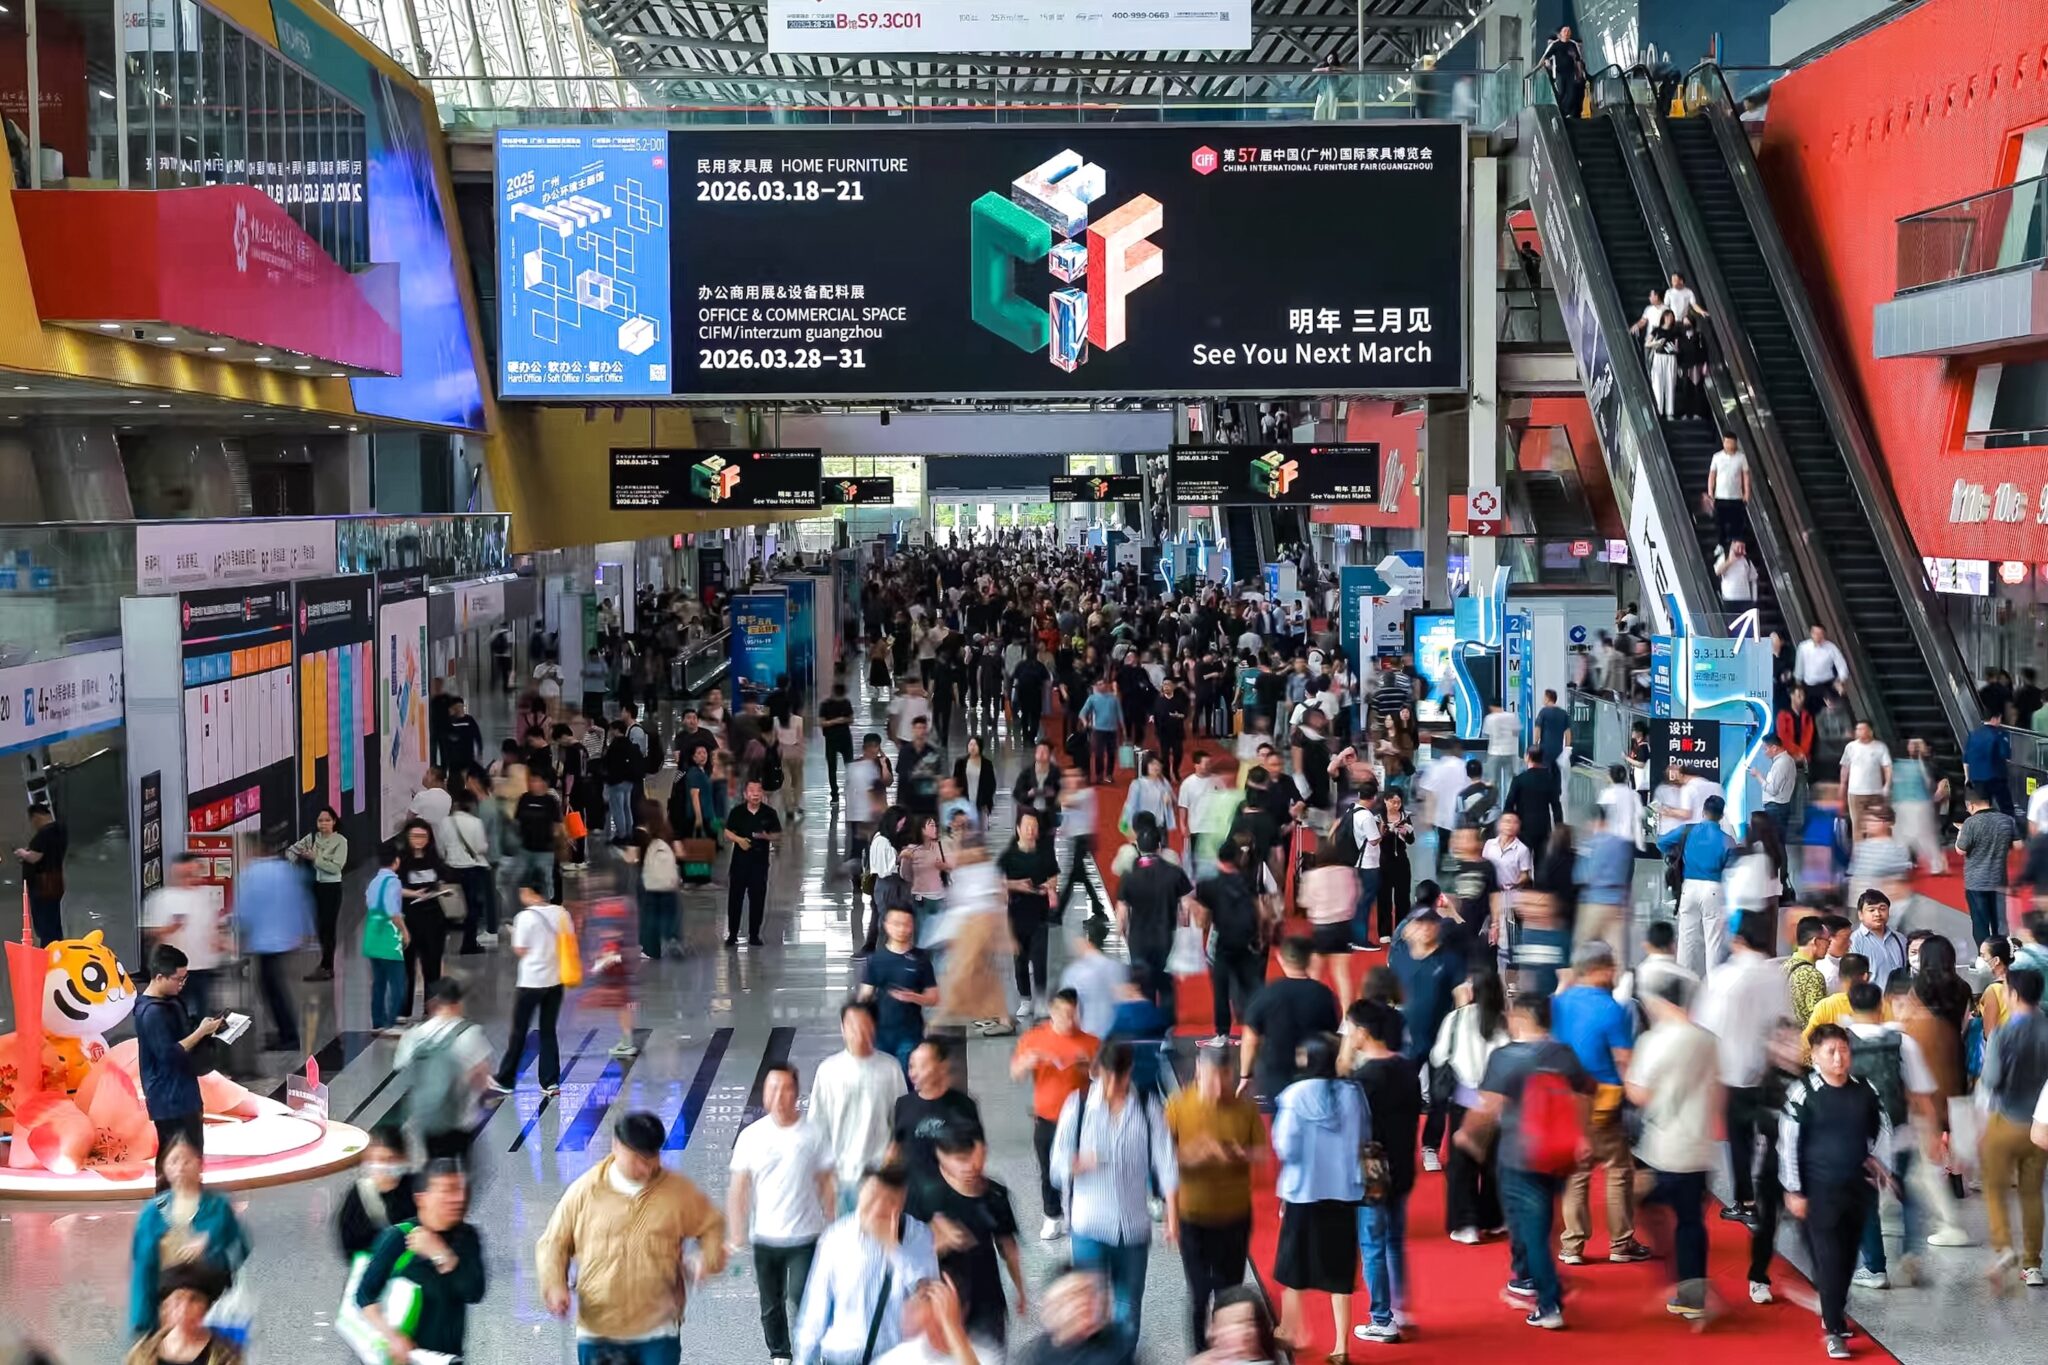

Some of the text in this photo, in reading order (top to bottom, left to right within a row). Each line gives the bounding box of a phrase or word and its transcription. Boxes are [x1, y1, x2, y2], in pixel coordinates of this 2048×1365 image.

[697, 158, 908, 174] 民用家具展 HOME FURNITURE
[1223, 164, 1248, 172] CHINA
[1250, 163, 1312, 172] INTERNATIONAL
[1314, 163, 1359, 171] FURNITURE
[506, 170, 535, 192] 2025
[541, 171, 605, 204] 办公环境主题馆
[542, 175, 560, 191] 广州
[696, 180, 865, 202] 2026.03.18-21
[698, 284, 866, 301] 办公商用展&设备配料展
[699, 306, 907, 323] OFFICE & COMMERCIAL SPACE
[1289, 307, 1432, 334] 明年 三月见
[699, 325, 883, 342] CIFM/interzum guangzhou
[699, 349, 867, 370] 2026.03.28-31
[1193, 341, 1432, 365] See You Next March
[508, 373, 522, 383] Hard
[524, 373, 542, 383] Office
[548, 373, 560, 383] Soft
[562, 373, 580, 383] Office
[585, 373, 603, 383] Smart
[605, 373, 623, 383] Office
[1694, 648, 1736, 659] 9.3-11.3
[1750, 690, 1768, 698] Hall
[1668, 721, 1694, 736] 设计
[1668, 738, 1706, 752] 向新力
[1668, 756, 1719, 769] Powered
